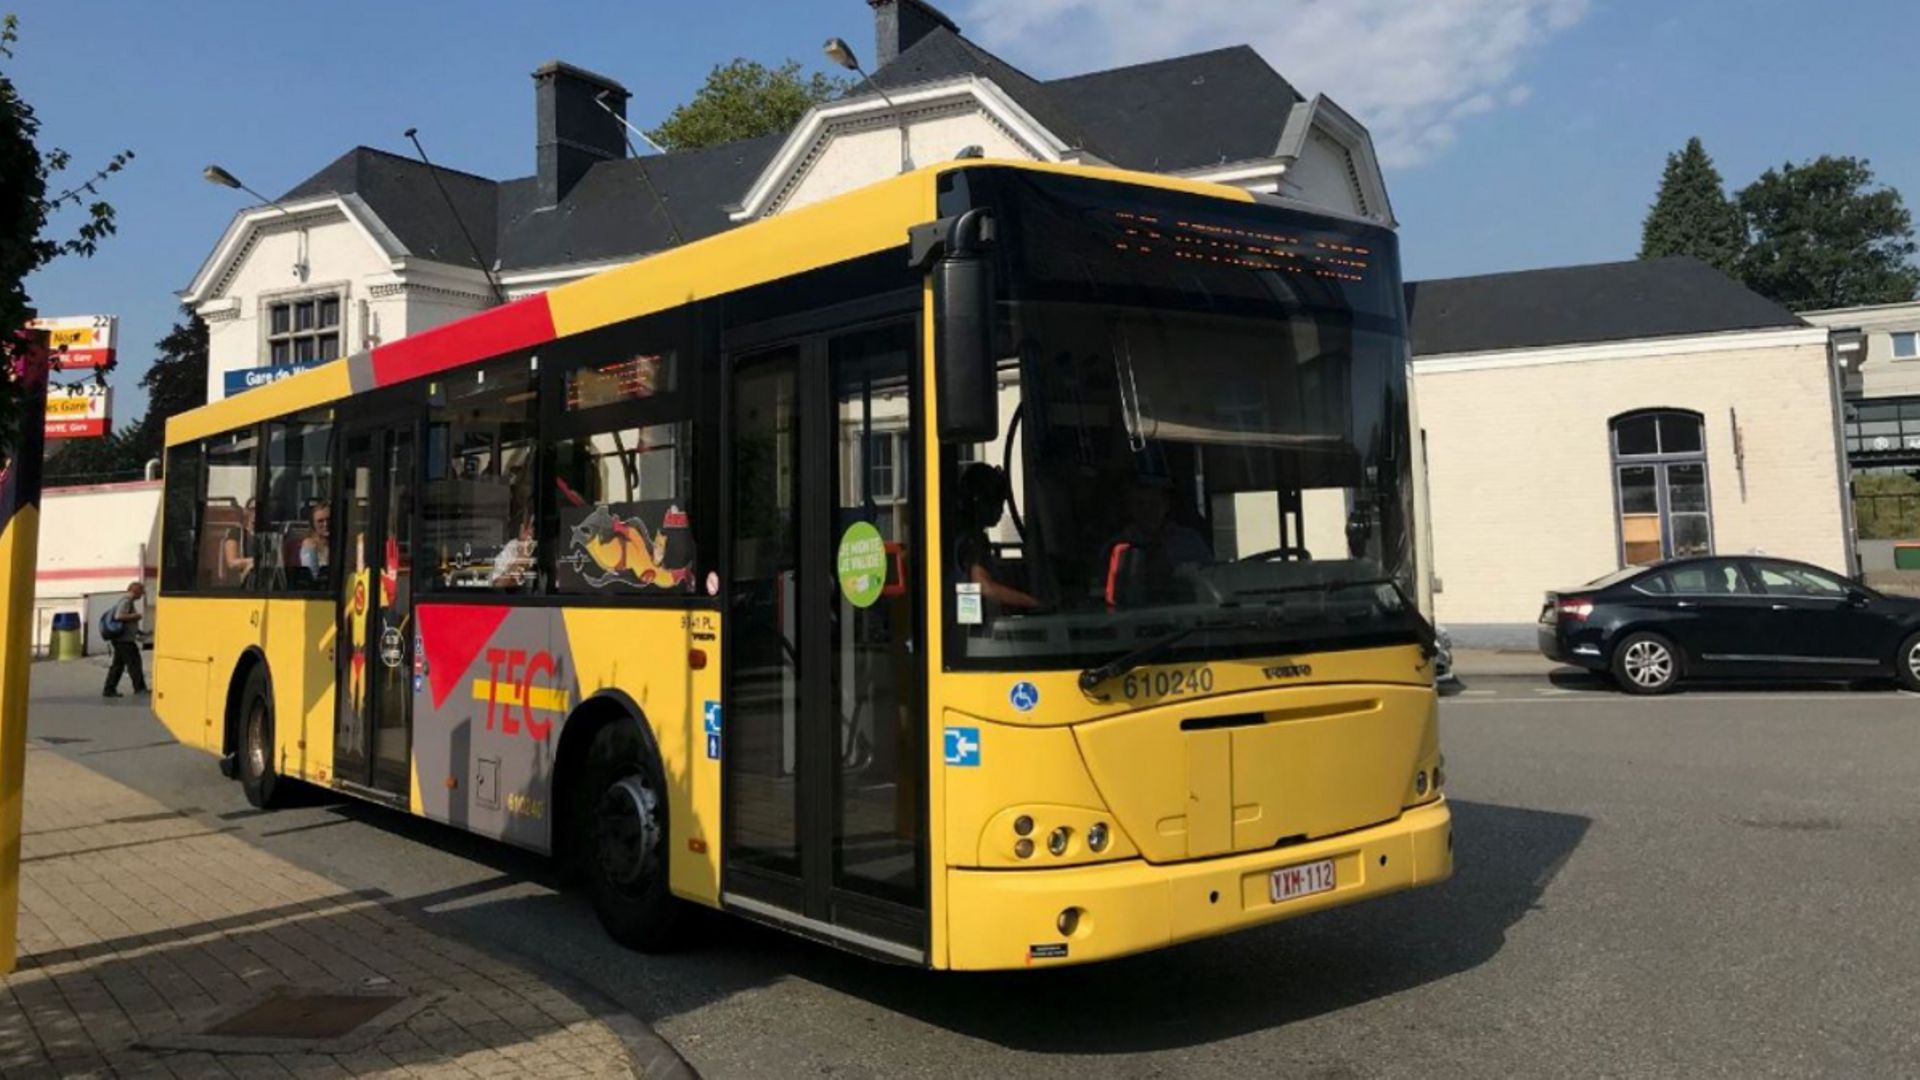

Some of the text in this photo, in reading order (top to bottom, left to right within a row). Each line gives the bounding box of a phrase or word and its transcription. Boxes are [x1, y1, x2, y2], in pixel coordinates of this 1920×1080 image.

[93, 316, 109, 327] 22
[246, 371, 273, 386] Gare
[89, 385, 105, 396] 22
[61, 400, 87, 413] Gare
[1123, 668, 1214, 699] 610240
[485, 647, 556, 742] TEC
[1273, 862, 1332, 899] YXM-112
